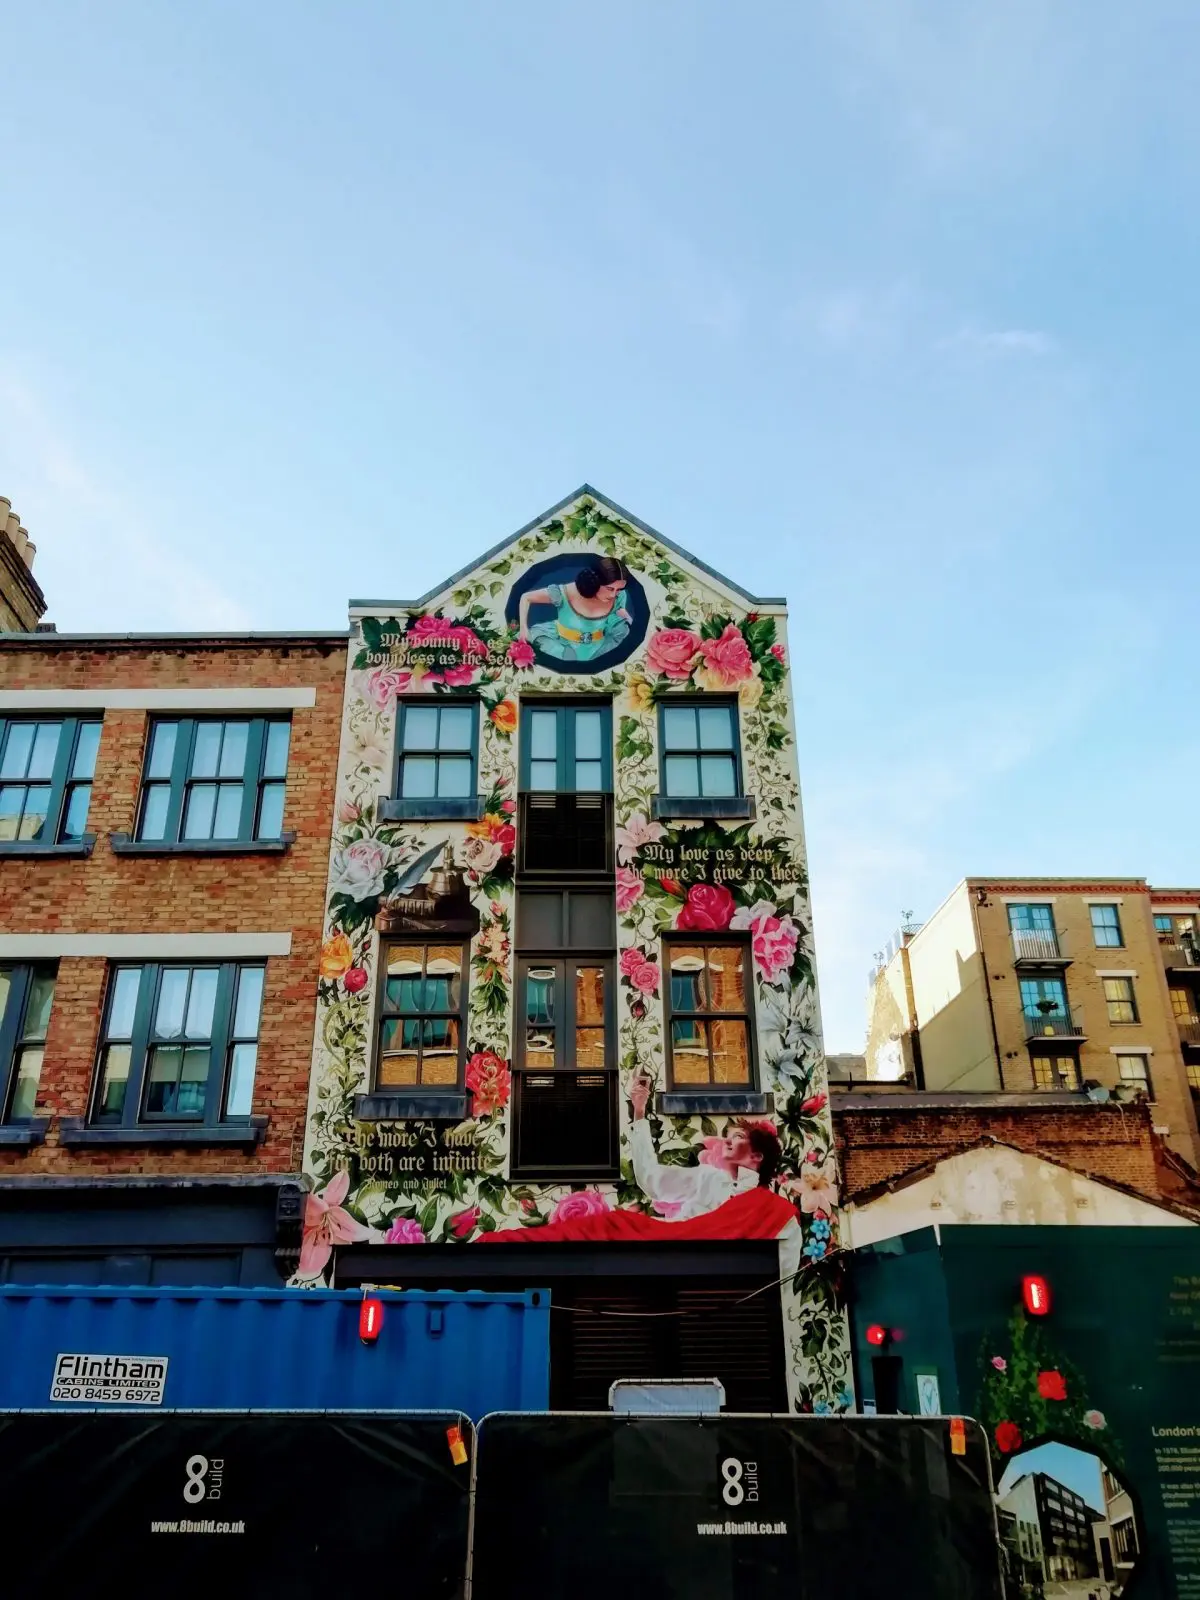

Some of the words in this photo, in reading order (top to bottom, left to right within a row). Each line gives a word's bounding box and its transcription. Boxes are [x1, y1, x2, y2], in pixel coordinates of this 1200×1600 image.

[380, 633, 410, 650] My
[411, 634, 460, 650] bounty
[467, 635, 480, 649] is
[487, 638, 504, 649] as
[366, 651, 435, 667] boundless
[440, 653, 457, 666] as
[461, 650, 482, 667] the
[487, 654, 513, 667] sea
[644, 844, 674, 863] My
[680, 844, 710, 861] love
[716, 849, 735, 861] as
[655, 866, 689, 881] more
[695, 863, 707, 881] I
[713, 865, 743, 884] give
[750, 865, 764, 881] to
[771, 863, 800, 882] thee
[378, 1131, 418, 1148] more
[444, 1128, 481, 1148] have
[359, 1151, 394, 1175] both
[398, 1156, 426, 1172] are
[433, 1151, 493, 1173] infinite
[403, 1177, 419, 1190] and
[57, 1356, 164, 1379] Flintham
[57, 1378, 104, 1386] CABINS
[108, 1379, 160, 1389] LIMITED
[53, 1387, 81, 1399] 020
[84, 1388, 121, 1400] 8459
[126, 1389, 160, 1402] 6972
[183, 1454, 209, 1504] 8
[206, 1459, 225, 1500] build
[721, 1457, 744, 1506] 8
[743, 1462, 759, 1502] build
[151, 1520, 246, 1534] www.8build.co.uk
[697, 1521, 788, 1535] www.8build.co.uk
